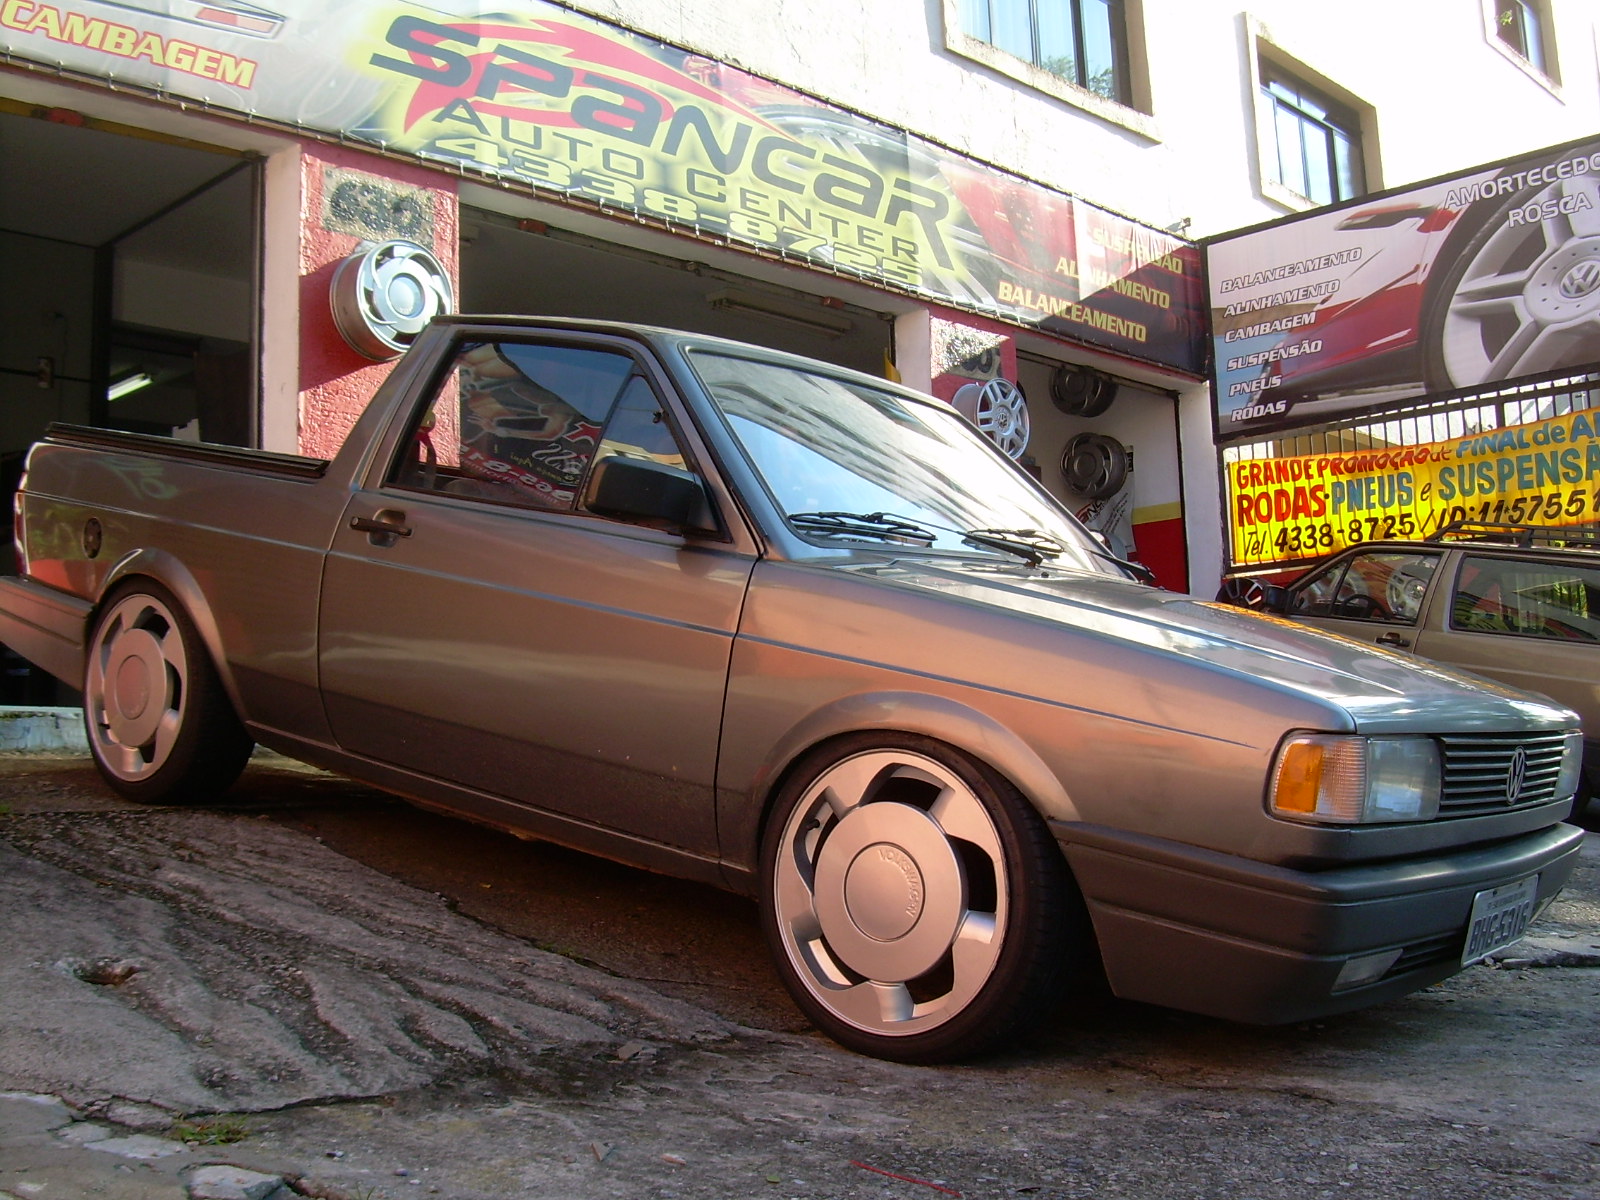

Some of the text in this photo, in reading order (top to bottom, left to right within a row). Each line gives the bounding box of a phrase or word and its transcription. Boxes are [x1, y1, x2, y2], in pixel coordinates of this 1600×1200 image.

[0, 0, 257, 89] CAMBAGEM
[431, 98, 920, 262] AUTO CENTER
[432, 136, 923, 288] 4338-8725
[1508, 191, 1593, 228] ROSCA
[1220, 247, 1363, 294] BALANCEAMENTO
[997, 280, 1147, 343] BALANCEAMENTO
[1223, 279, 1341, 318] ALINHAMENTO
[1224, 311, 1317, 344] CAMBAGEM
[1226, 339, 1323, 372] SUSPENSÃO
[1228, 374, 1283, 398] PNEUS
[1230, 399, 1287, 423] RODAS
[1236, 458, 1315, 489] GRANDE
[1316, 447, 1430, 480] PROMOÇÃO
[1455, 427, 1531, 459] FINAL
[1532, 422, 1566, 446] de
[1236, 484, 1327, 528] RODAS
[1330, 471, 1414, 516] PNEUS
[1420, 482, 1433, 501] e
[1244, 530, 1269, 557] Tel.
[1273, 512, 1416, 553] 4338-8725
